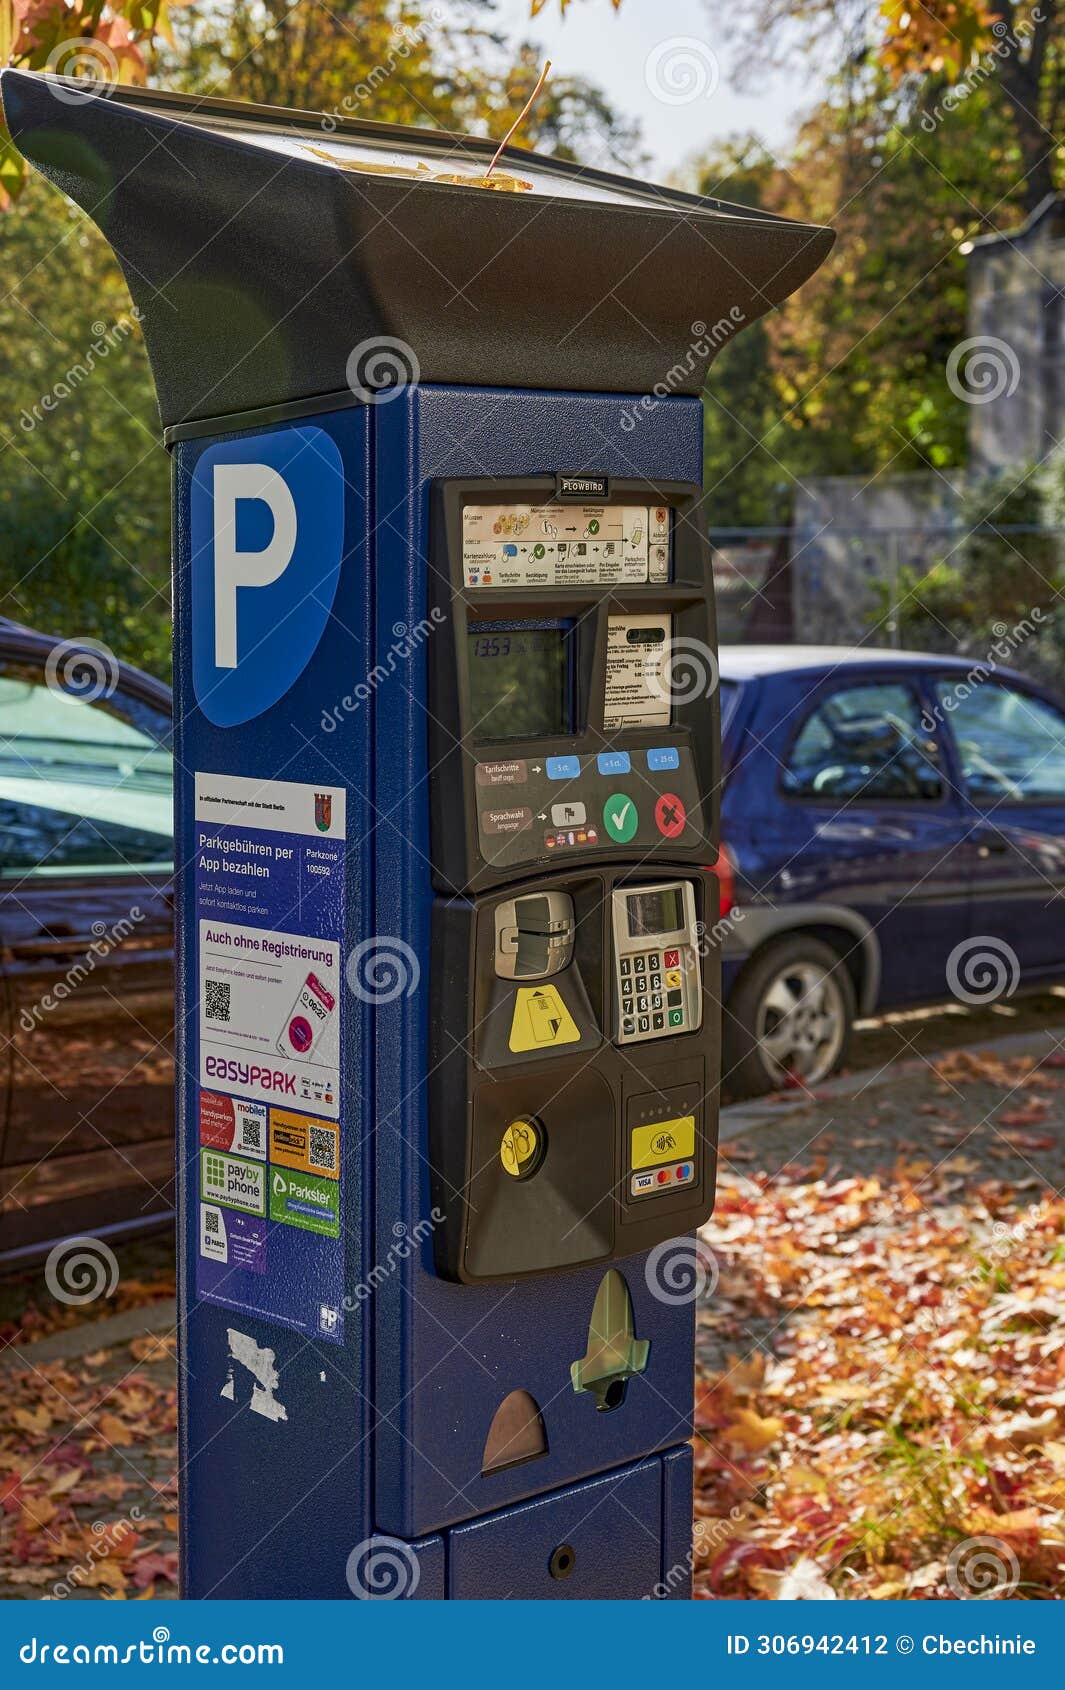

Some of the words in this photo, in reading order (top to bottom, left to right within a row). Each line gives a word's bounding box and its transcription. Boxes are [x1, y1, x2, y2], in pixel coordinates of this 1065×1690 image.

[563, 482, 603, 492] FLOWBIRD
[463, 552, 497, 560] Kartenzahlung
[213, 463, 297, 669] P
[485, 764, 520, 774] Tarifschritte
[489, 810, 525, 823] Sprachwahl
[199, 833, 273, 857] Parkgebühren
[275, 848, 294, 860] per
[306, 848, 338, 862] Parkzone
[199, 856, 220, 872] App
[222, 858, 270, 878] bezahlen
[199, 881, 213, 891] Jetzt
[214, 884, 227, 895] App
[228, 885, 244, 896] laden
[245, 889, 257, 898] und
[199, 896, 216, 906] sofort
[216, 899, 247, 912] kontaktlos
[248, 904, 269, 915] parken
[205, 929, 232, 946] Auch
[233, 935, 260, 950] ohne
[261, 939, 333, 968] Registrierung
[622, 961, 628, 972] 1
[637, 958, 644, 970] 2
[651, 956, 658, 968] 3
[623, 981, 630, 993] 4
[639, 979, 645, 991] 5
[653, 976, 660, 988] 6
[624, 1001, 631, 1012] 7
[640, 999, 647, 1011] 8
[654, 996, 661, 1008] 9
[641, 1018, 648, 1030] 0
[237, 1103, 266, 1117] mobilet
[227, 1162, 259, 1183] payby
[227, 1179, 261, 1198] phone
[637, 1178, 652, 1187] VISA
[206, 1191, 260, 1210] www.paybyphone.com
[289, 1182, 331, 1206] Parkster
